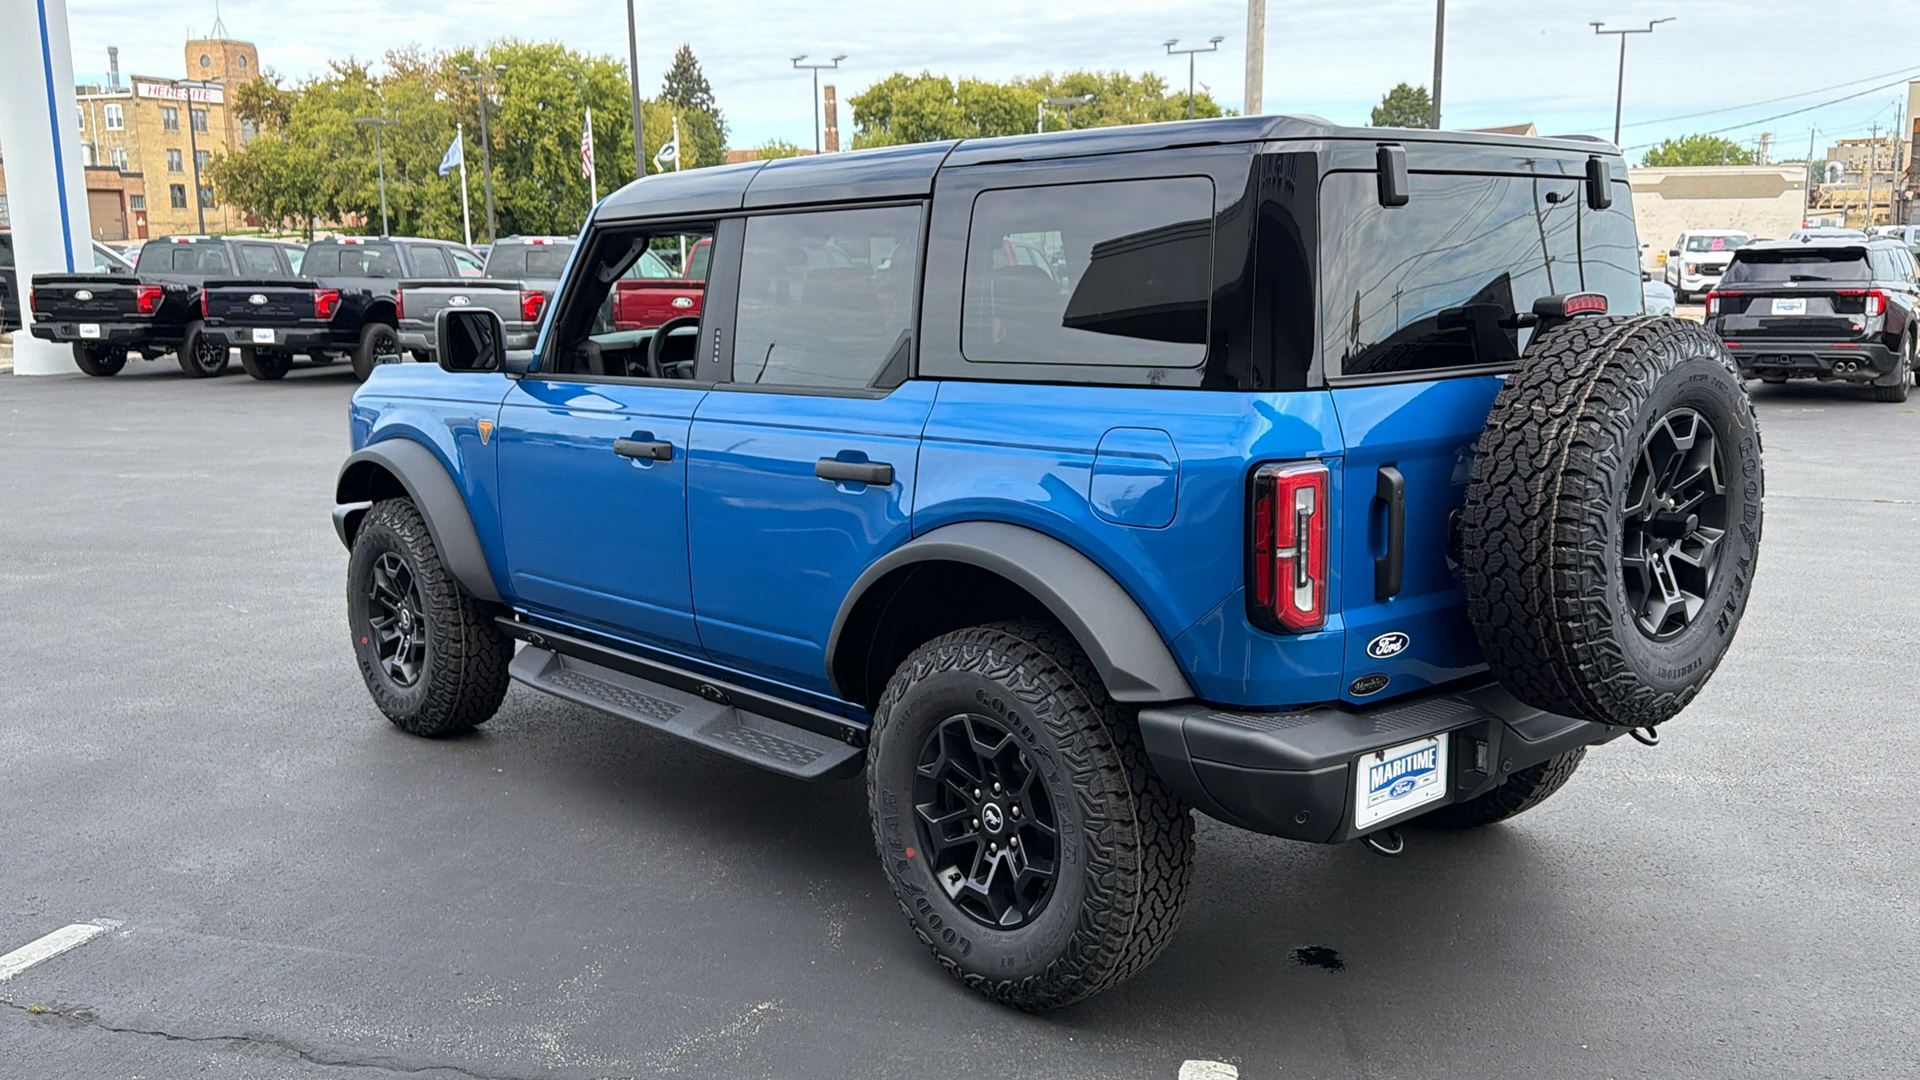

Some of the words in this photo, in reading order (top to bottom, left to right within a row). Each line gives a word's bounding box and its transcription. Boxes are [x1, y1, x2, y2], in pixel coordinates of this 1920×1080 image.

[148, 84, 211, 101] HERESITE
[1376, 635, 1403, 655] Ford
[1371, 747, 1436, 791] MARITIME
[1392, 780, 1413, 796] Ford
